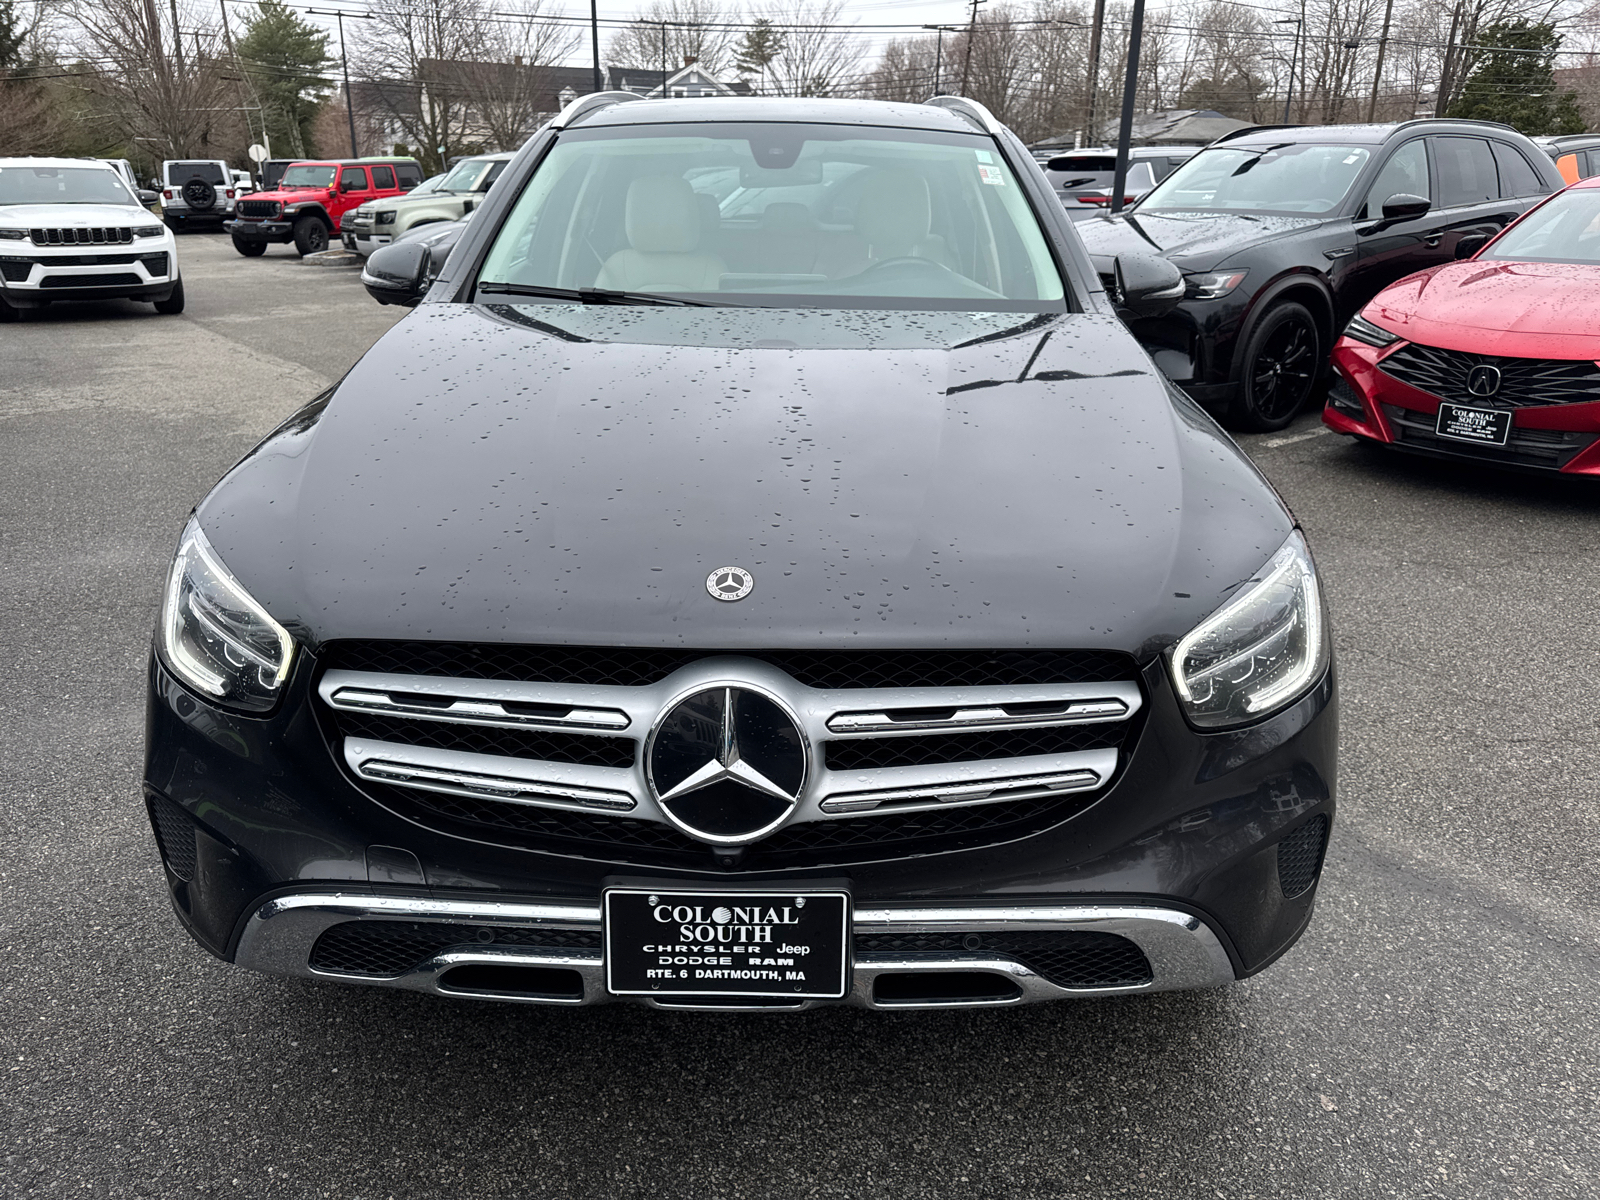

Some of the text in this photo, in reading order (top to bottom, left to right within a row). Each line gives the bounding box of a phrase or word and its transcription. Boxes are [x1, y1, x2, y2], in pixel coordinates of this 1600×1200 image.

[1452, 409, 1496, 421] COLONIAL
[1458, 416, 1487, 426] SOUTH
[653, 905, 799, 924] COLONIAL
[680, 924, 773, 943] SOUTH
[642, 943, 811, 956] CHRYSLER Jeep
[658, 956, 794, 966] DODGE RAM
[646, 969, 806, 982] RTE. 6 DARTMOUTH, MA
